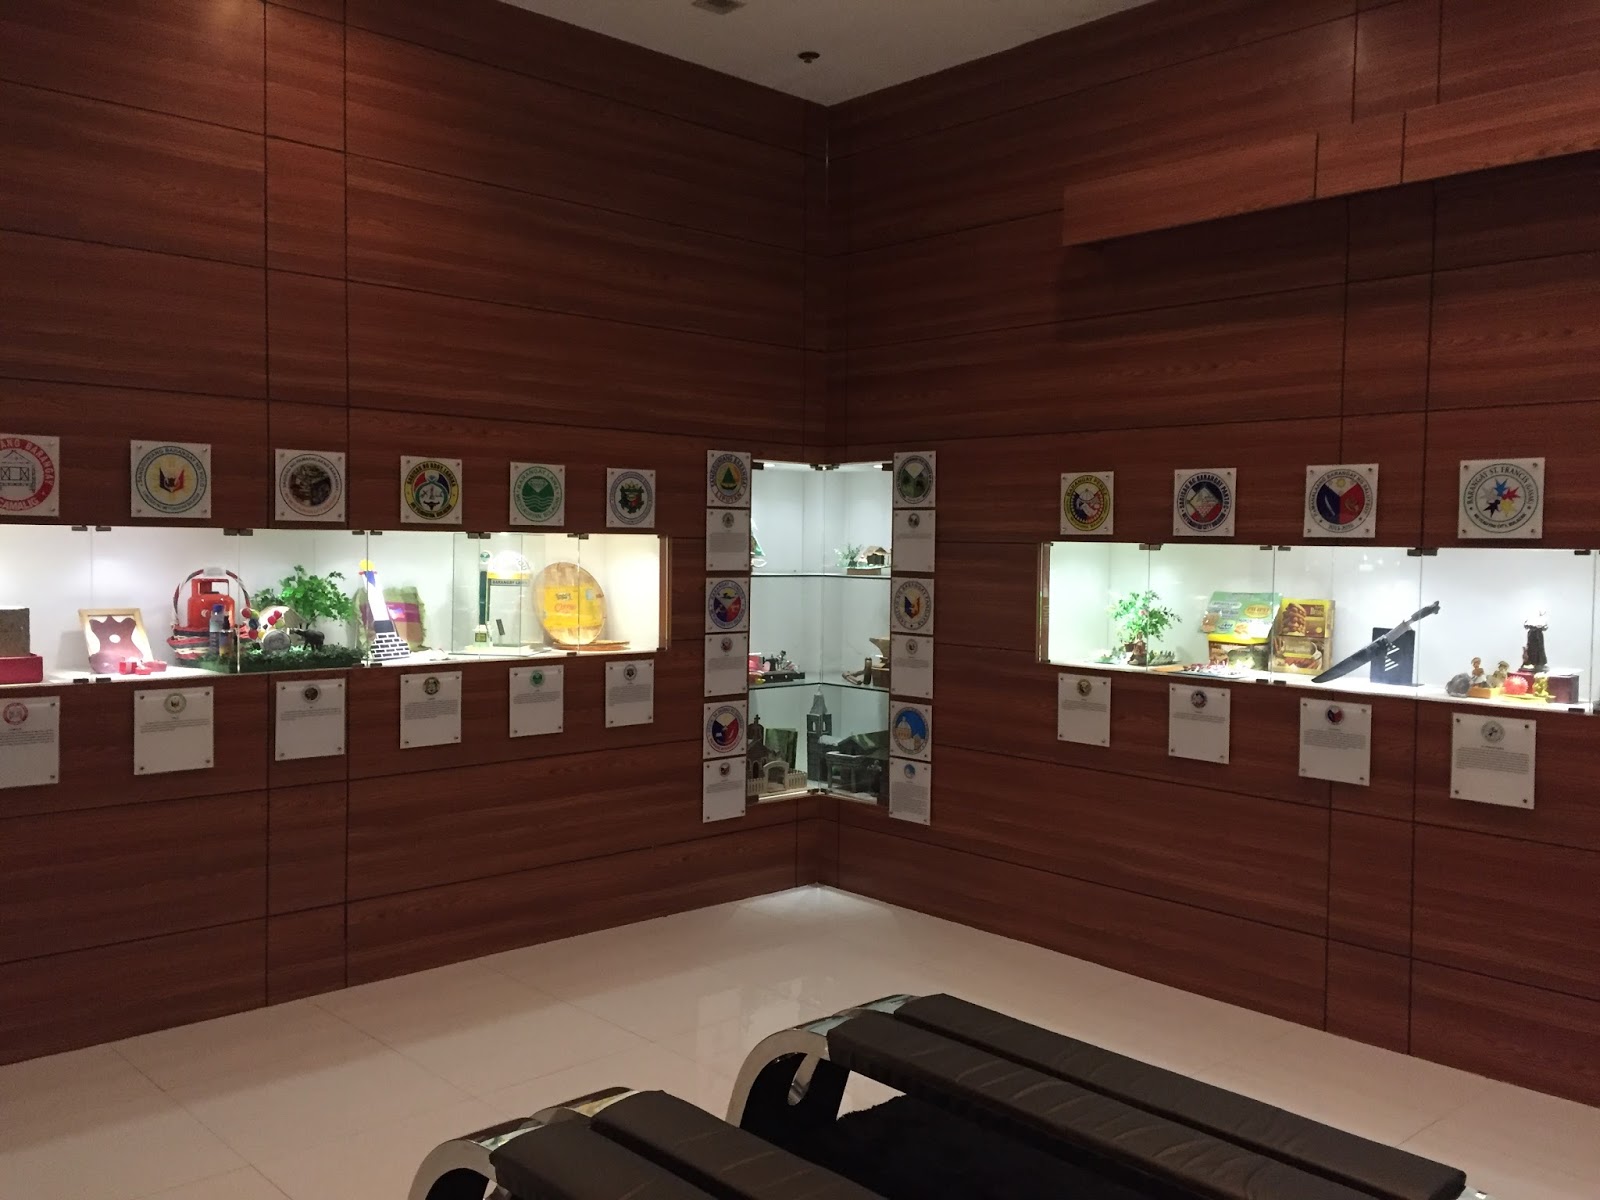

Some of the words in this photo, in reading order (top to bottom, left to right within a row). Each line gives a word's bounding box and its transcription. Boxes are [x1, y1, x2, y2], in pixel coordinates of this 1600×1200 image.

[25, 442, 54, 486] BARANGAY
[1066, 476, 1092, 497] BARANGAY
[1467, 472, 1488, 504] BARANGAY
[1501, 466, 1529, 484] FRANCIS
